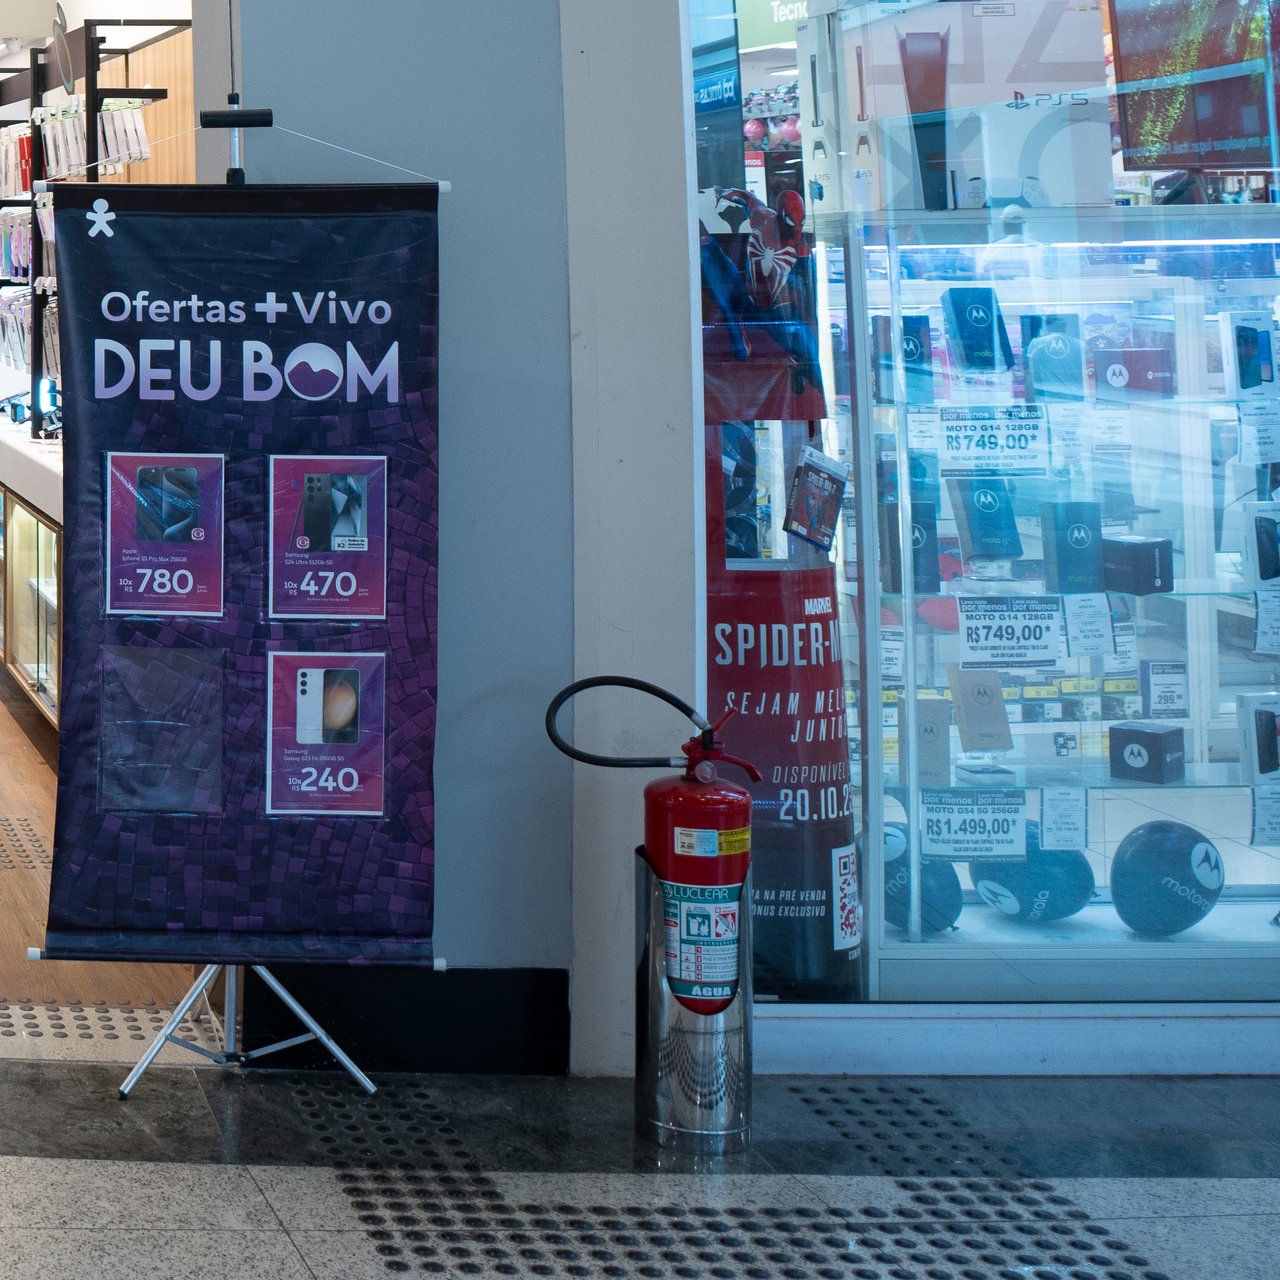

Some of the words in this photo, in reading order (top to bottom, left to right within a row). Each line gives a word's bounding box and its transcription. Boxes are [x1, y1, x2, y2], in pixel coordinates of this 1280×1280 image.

[1035, 93, 1089, 107] PS5
[101, 291, 246, 323] Ofertas
[94, 338, 222, 401] DEU
[243, 340, 399, 403] BOM
[943, 412, 959, 420] por
[960, 411, 989, 419] menos
[1012, 410, 1041, 418] menos
[946, 424, 977, 432] MOTO
[980, 424, 1001, 432] G14
[1004, 423, 1039, 431] 128GB
[119, 578, 133, 586] 10x
[136, 568, 194, 593] 780
[284, 581, 298, 589] 10x
[300, 571, 357, 596] 470
[804, 596, 833, 615] MARVEL
[961, 604, 976, 612] por
[978, 603, 1007, 611] menos
[965, 613, 995, 621] MOTO
[999, 613, 1018, 621] G14
[724, 691, 800, 715] SEJAM
[300, 766, 359, 792] 240
[772, 761, 846, 784] DISPONÍVEL
[288, 777, 301, 785] 10x
[924, 797, 939, 805] por
[941, 796, 973, 804] menos
[978, 797, 993, 805] por
[995, 796, 1024, 804] menos
[926, 806, 955, 814] MOTO
[957, 806, 975, 814] G54
[991, 806, 1020, 814] 256GB
[673, 885, 729, 900] LUCLEAR
[764, 889, 775, 900] NA
[779, 888, 797, 901] PRÉ
[799, 889, 826, 901] VENDA
[778, 904, 826, 917] EXCLUSIVO
[691, 984, 732, 997] ÁGUA
